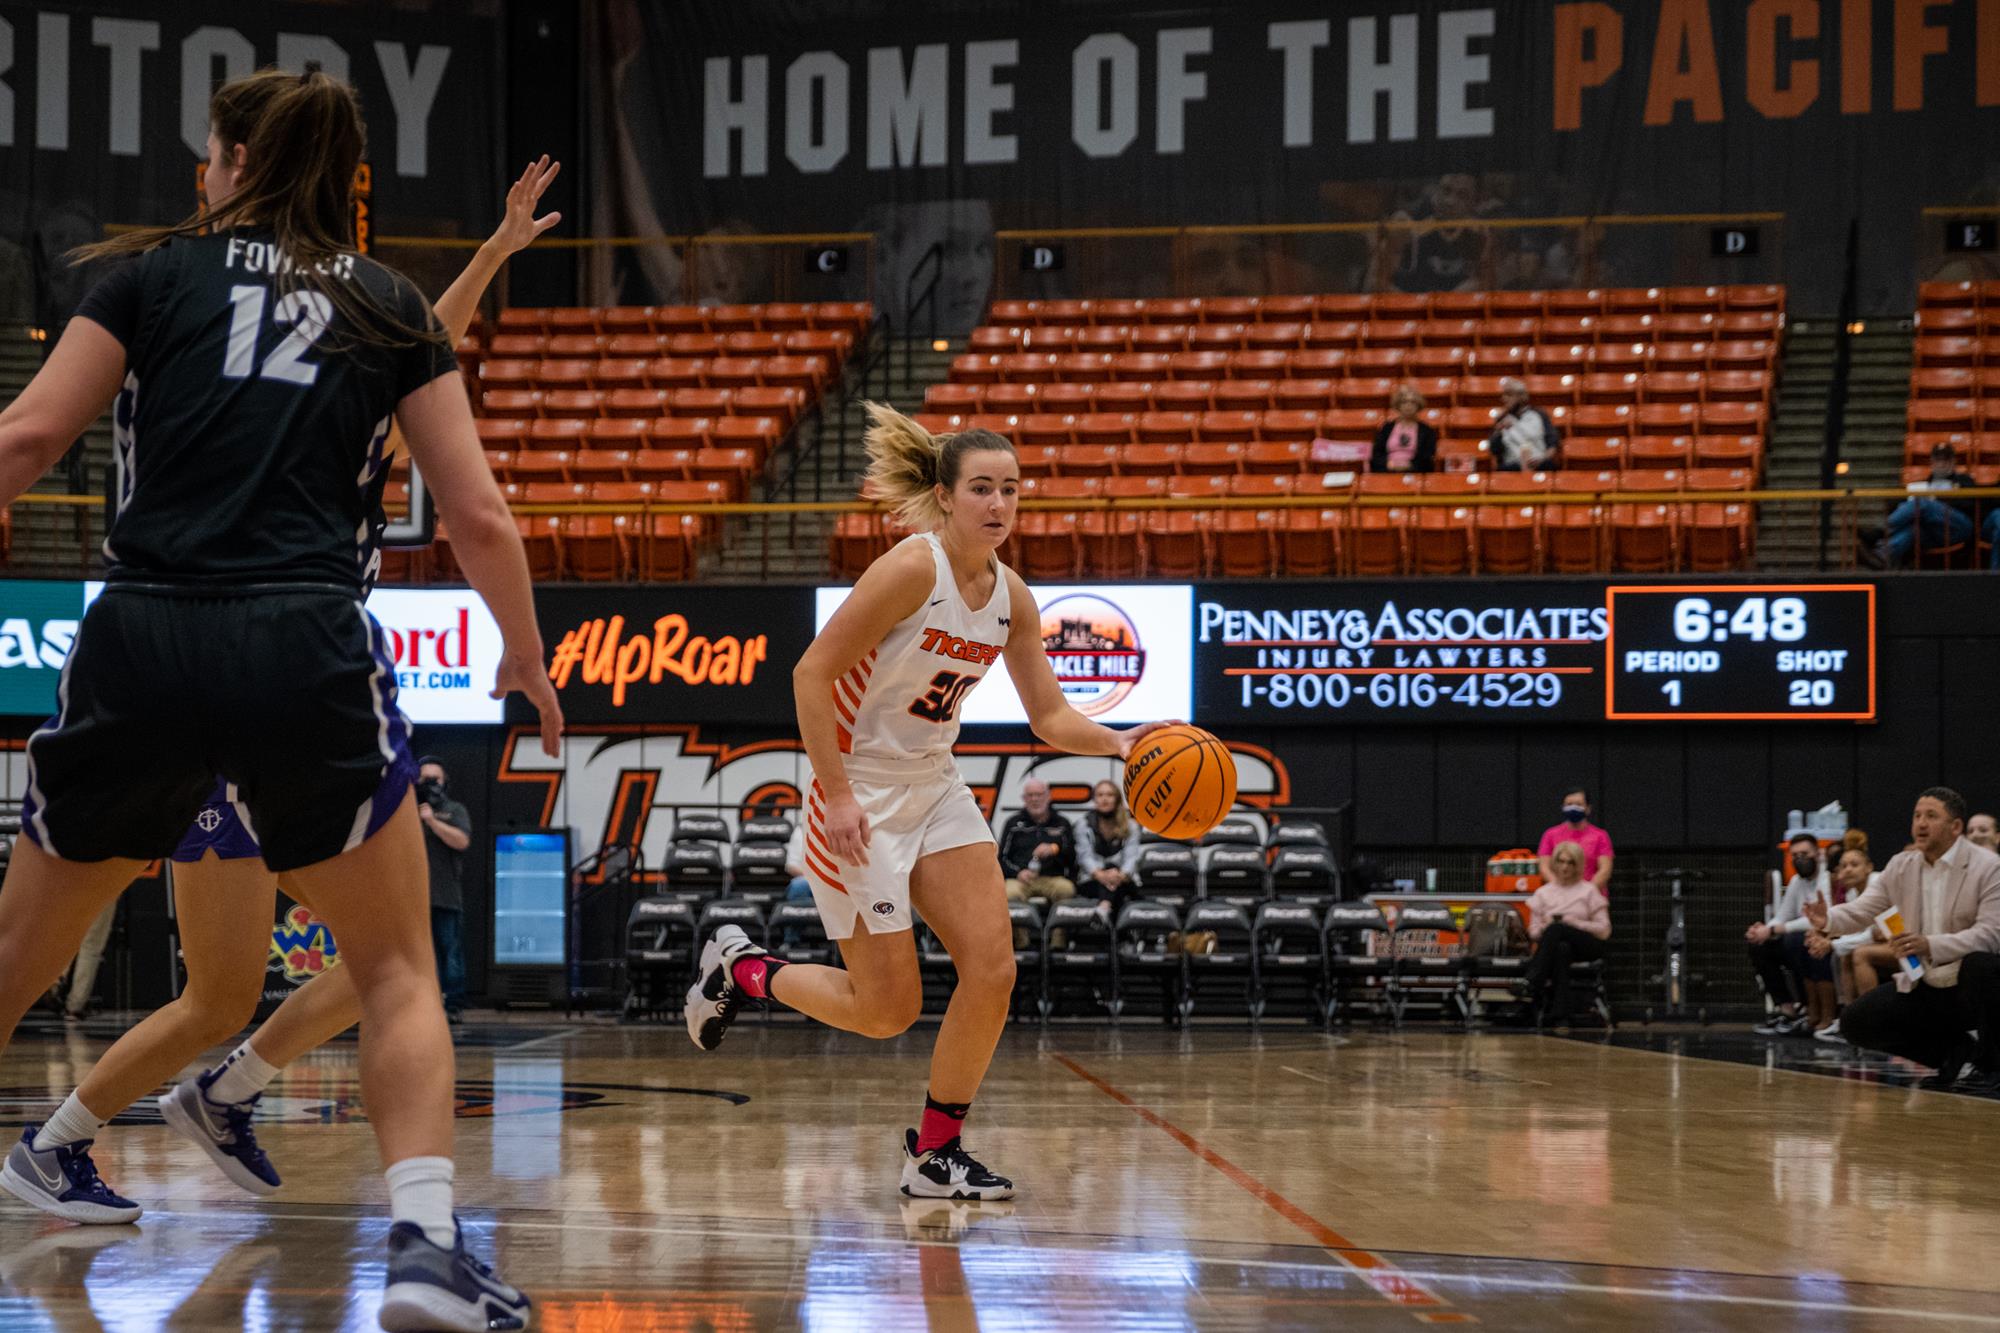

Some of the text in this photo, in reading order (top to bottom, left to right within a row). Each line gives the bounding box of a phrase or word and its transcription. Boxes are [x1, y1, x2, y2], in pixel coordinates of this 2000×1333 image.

[0, 11, 452, 178] ITOY
[703, 39, 1019, 178] HOME
[1071, 26, 1213, 157] OF
[1267, 8, 1496, 148] THE
[817, 249, 839, 273] C
[1033, 247, 1054, 269] D
[222, 284, 333, 386] 12
[1672, 597, 1808, 643] 6:48
[548, 613, 768, 708] #UpRoar
[1098, 654, 1140, 678] MILE
[1257, 647, 1549, 669] INJURY LAWYERS
[1625, 649, 1849, 673] PERIOD SHOT
[1240, 672, 1563, 708] 1-800-616-4529
[1661, 679, 1835, 707] 1 20
